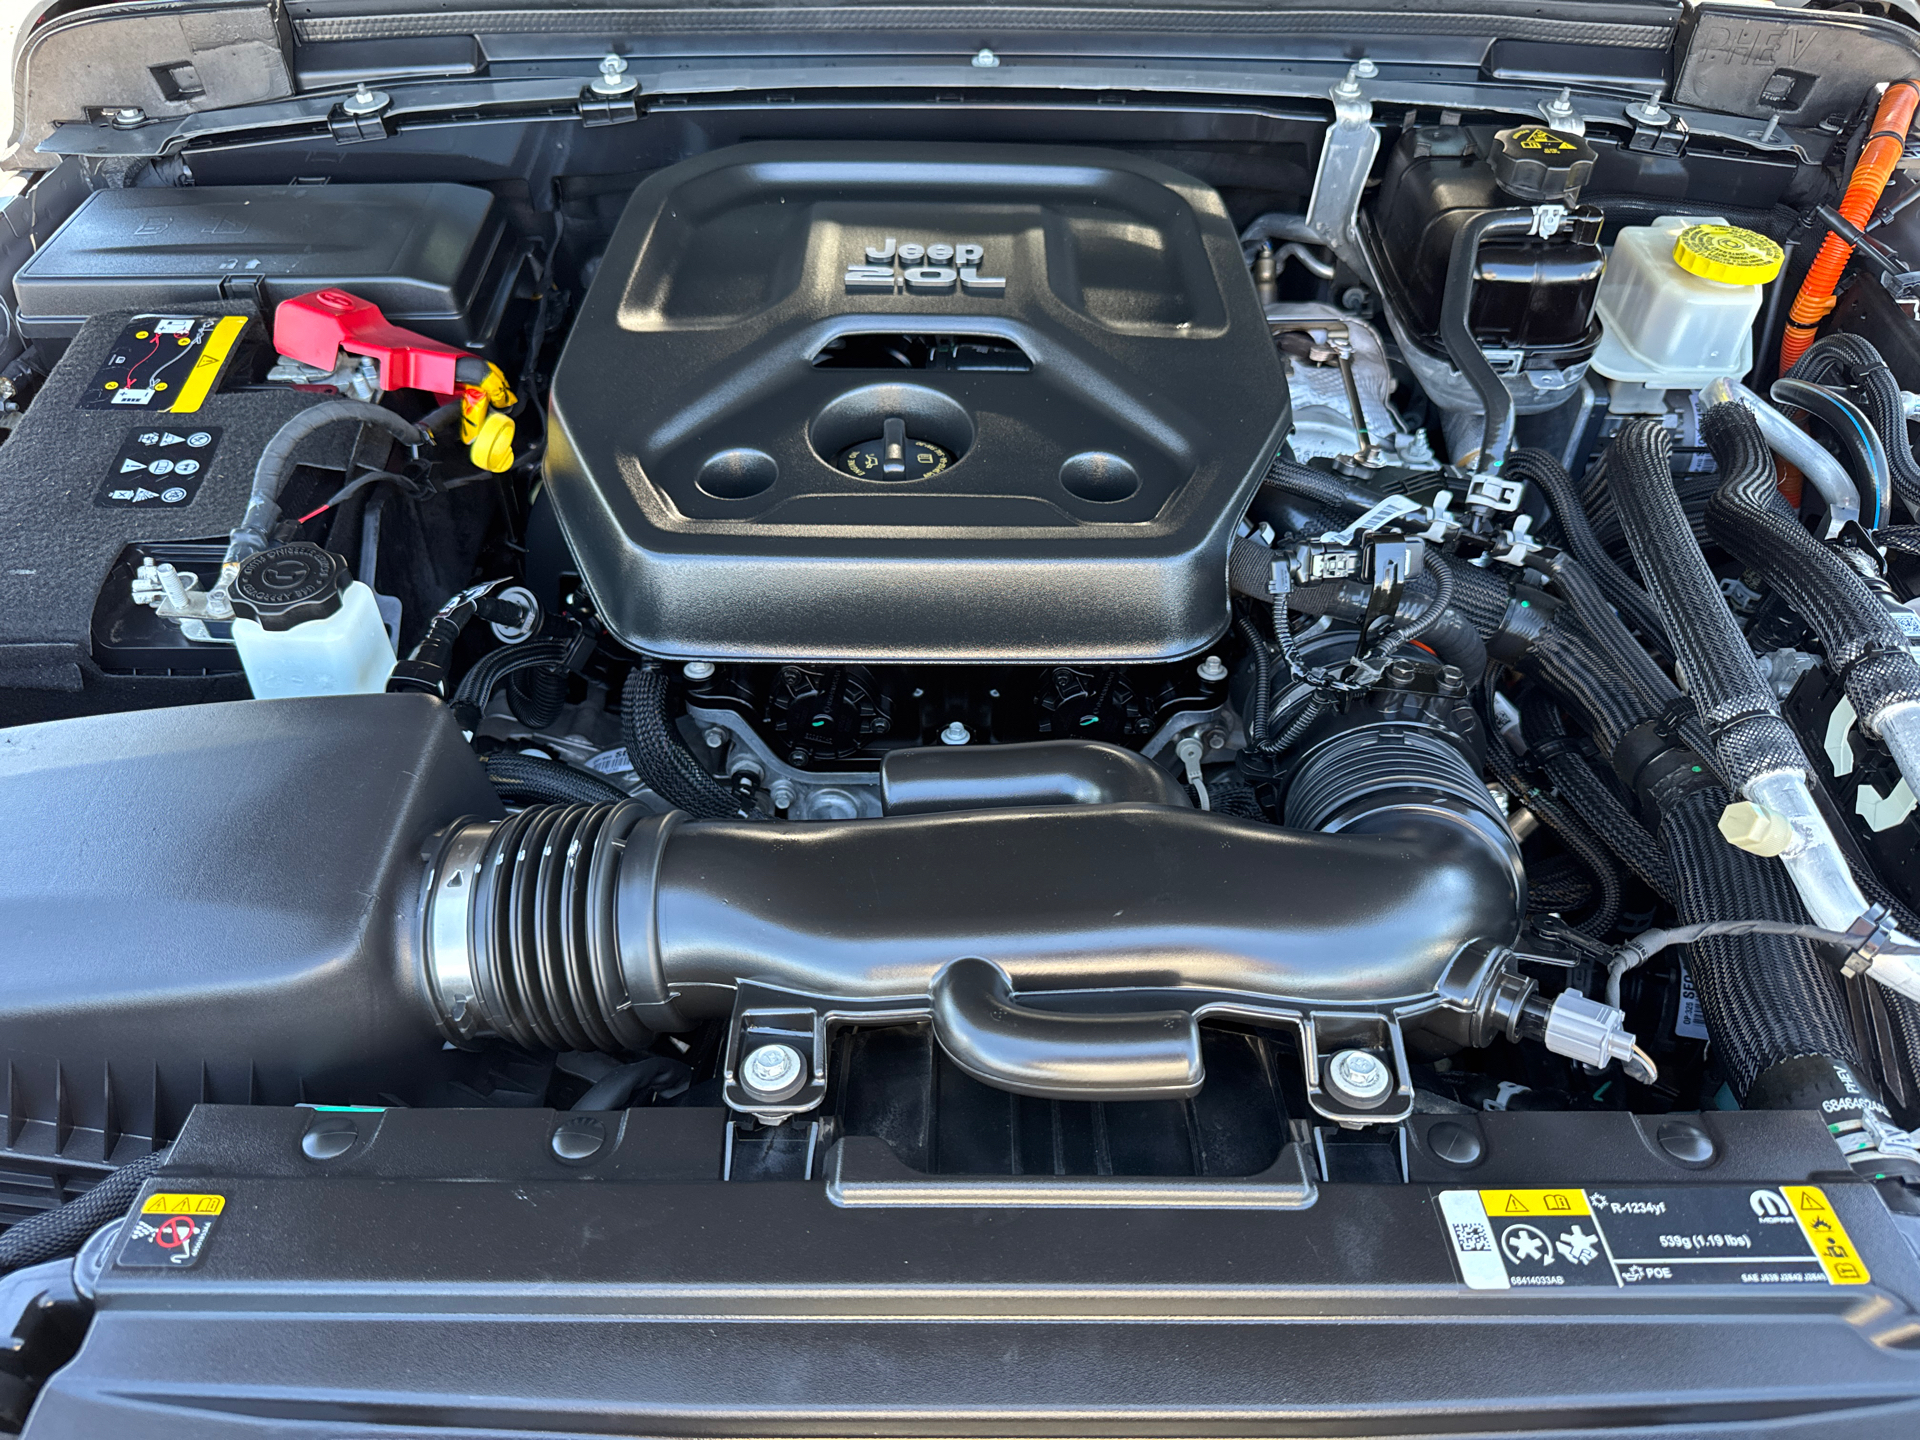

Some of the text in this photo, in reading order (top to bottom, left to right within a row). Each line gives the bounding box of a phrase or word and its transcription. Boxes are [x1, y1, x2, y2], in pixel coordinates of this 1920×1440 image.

[1698, 26, 1819, 66] PHEV
[865, 238, 984, 267] Jeep
[844, 265, 1006, 288] 2.0L
[243, 556, 267, 575] FLUID
[243, 583, 292, 602] APPROVED
[1833, 1065, 1860, 1094] PHEV
[1610, 1201, 1667, 1216] R-1234yf
[1758, 1216, 1795, 1225] MOPAR
[1659, 1234, 1752, 1250] 539g (1.19 lbs)
[1645, 1267, 1673, 1279] POE
[1741, 1272, 1760, 1283] SAE
